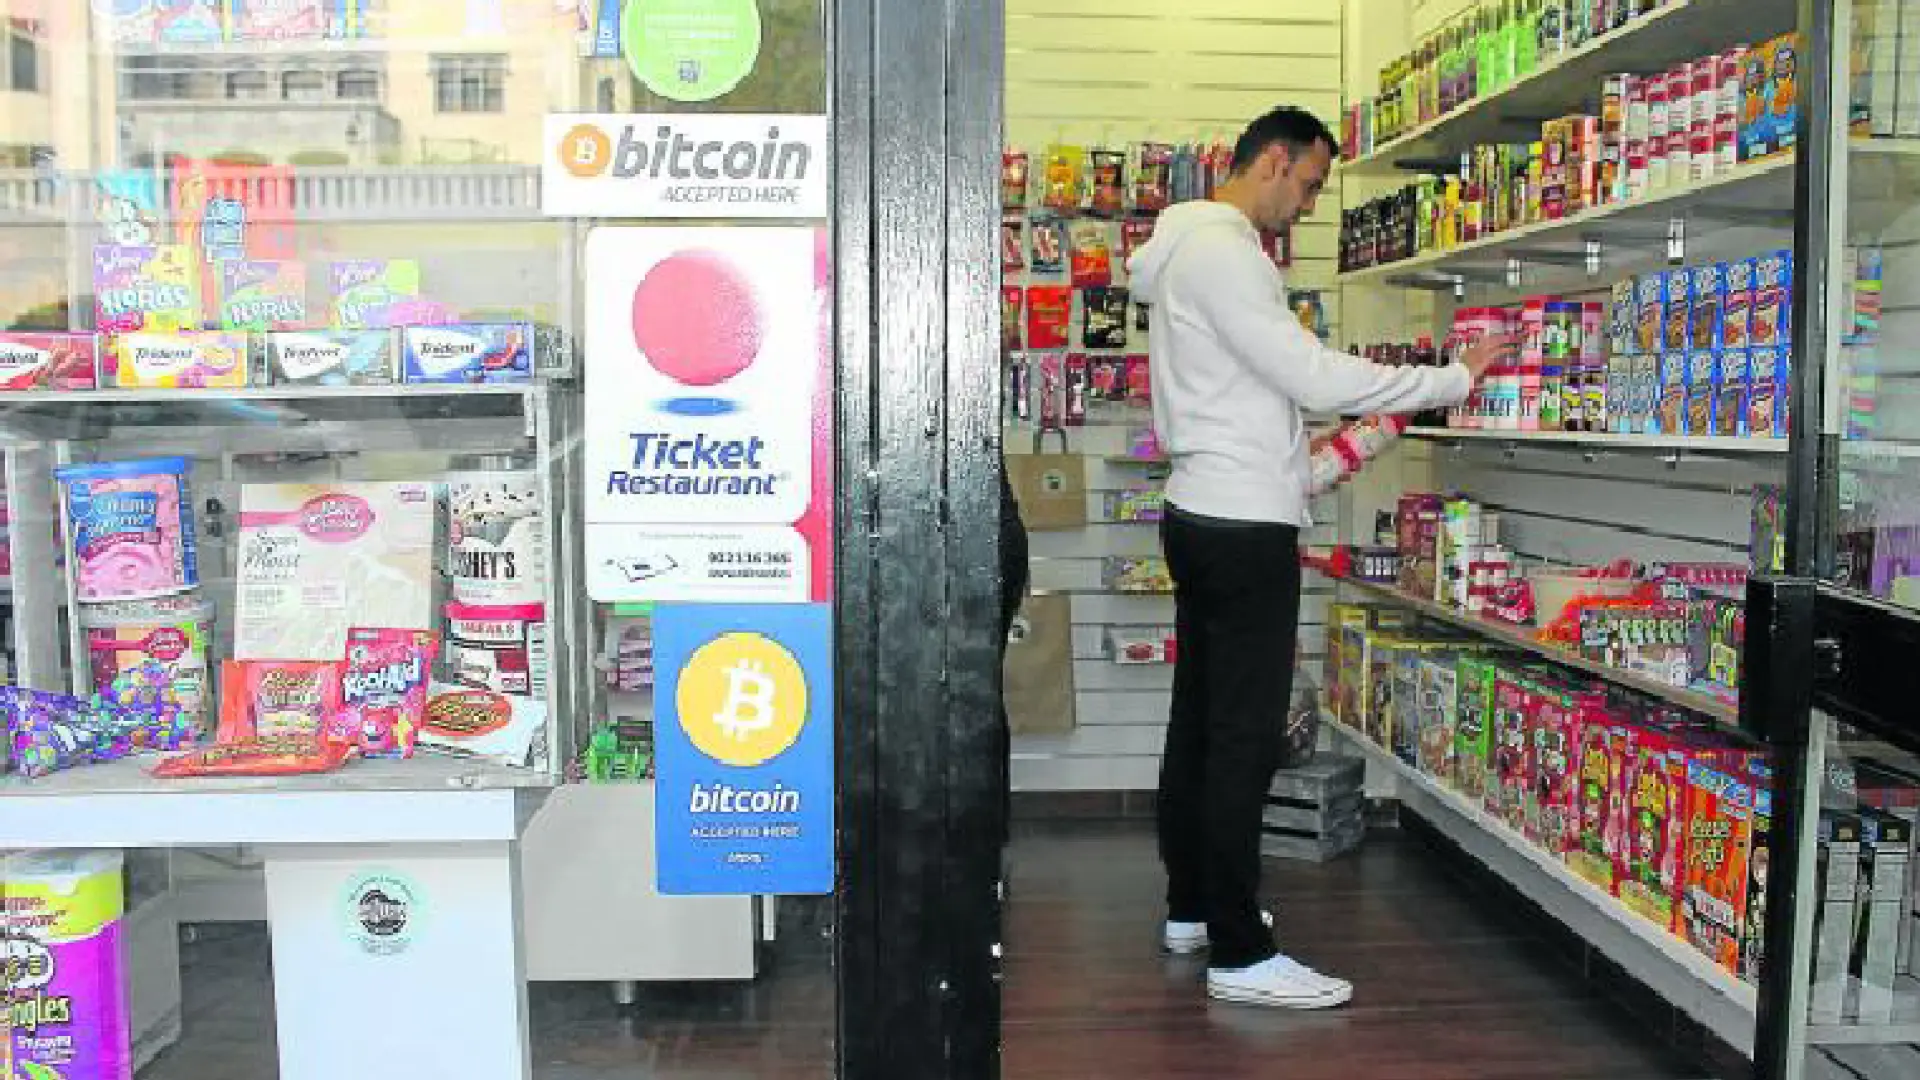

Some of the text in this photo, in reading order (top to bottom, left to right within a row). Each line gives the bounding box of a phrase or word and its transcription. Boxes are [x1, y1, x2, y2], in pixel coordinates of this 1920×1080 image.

[612, 125, 812, 180] bitcoin
[665, 186, 801, 204] ACCEPTED HERE
[136, 346, 193, 363] Trident
[420, 342, 475, 356] Trident
[630, 432, 765, 470] Ticket
[606, 470, 777, 495] Restaurant
[690, 782, 800, 813] bitcoin
